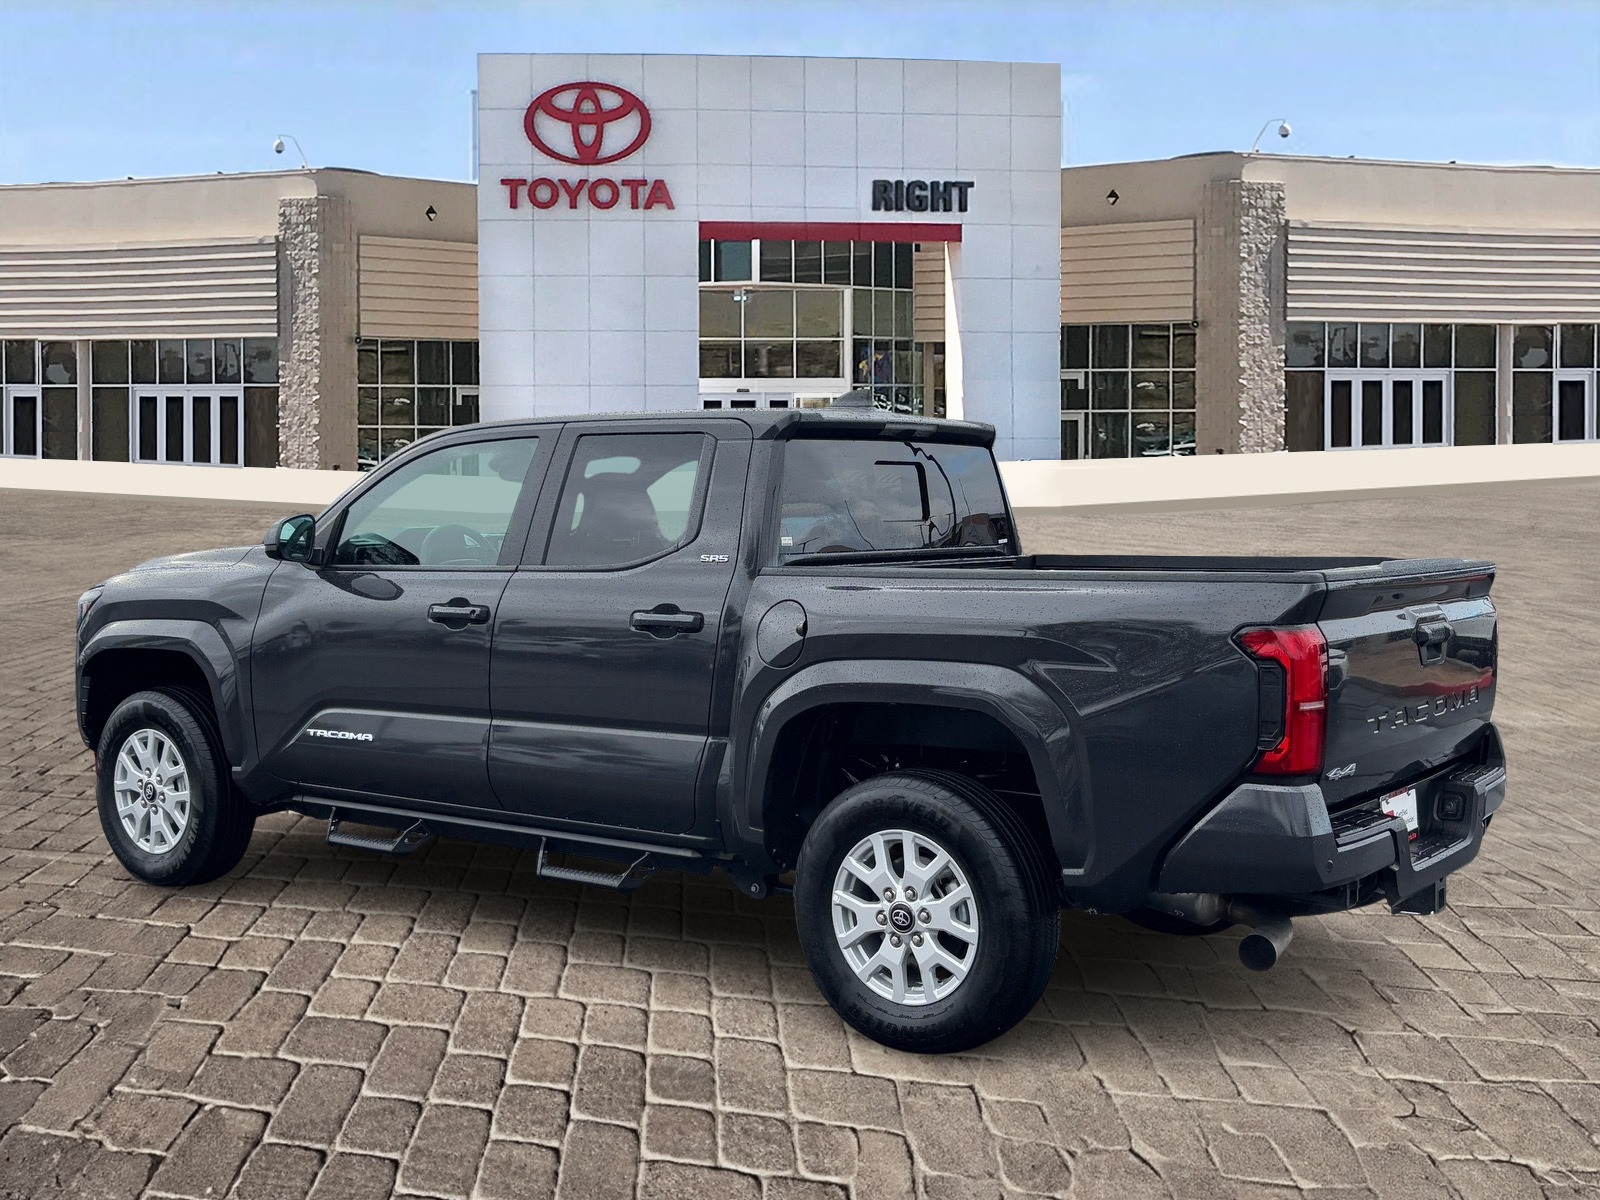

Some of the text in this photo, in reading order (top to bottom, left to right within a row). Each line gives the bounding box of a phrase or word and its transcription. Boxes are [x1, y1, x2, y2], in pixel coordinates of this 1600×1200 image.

[500, 178, 675, 210] TOYOTA
[872, 180, 975, 212] RIGHT
[700, 554, 729, 563] SR5
[1367, 685, 1479, 734] TACOMA
[306, 728, 374, 742] TACOMA
